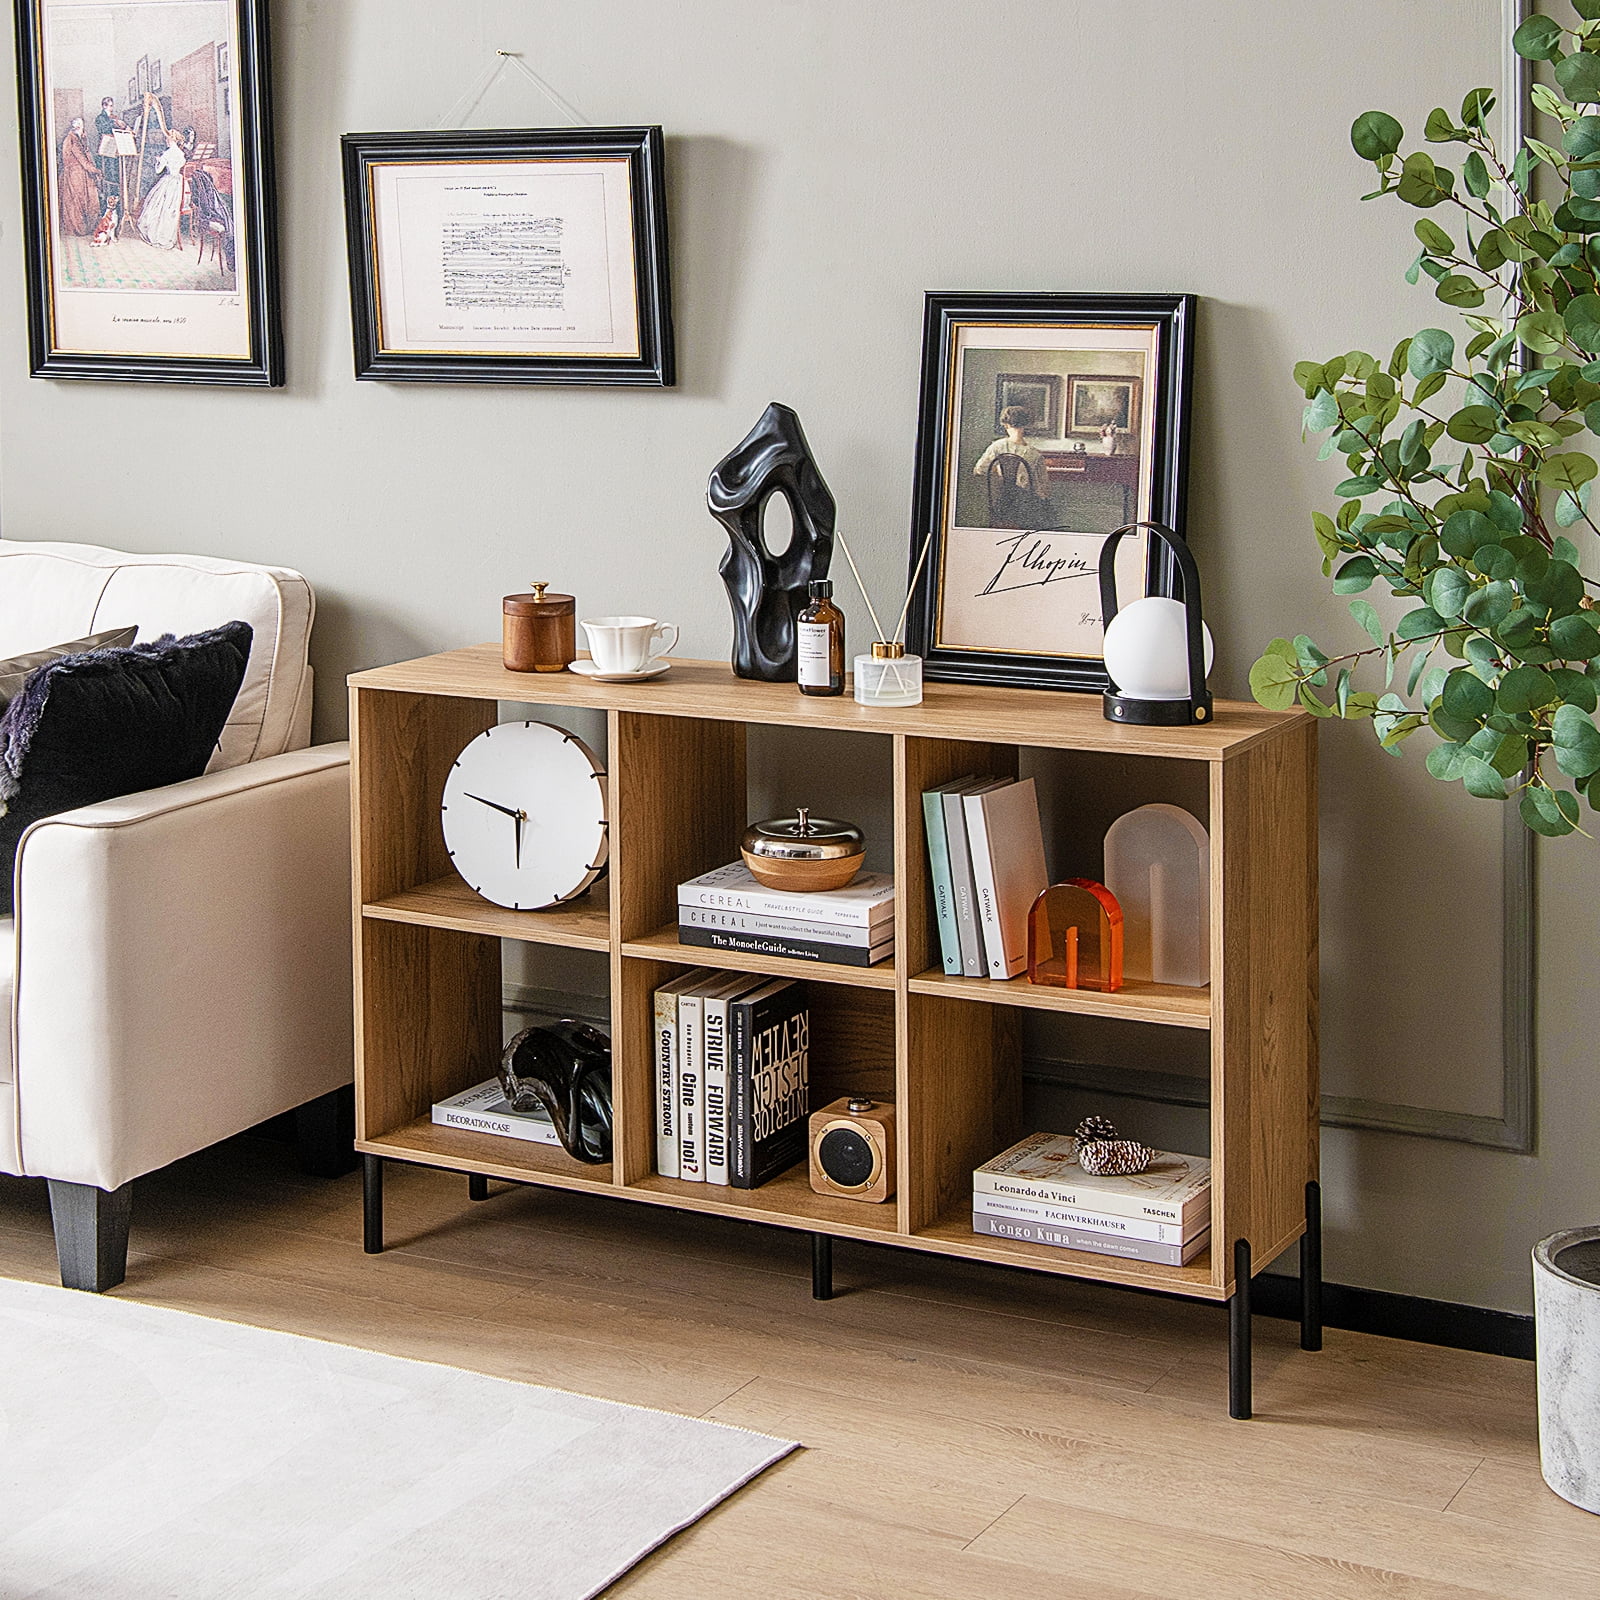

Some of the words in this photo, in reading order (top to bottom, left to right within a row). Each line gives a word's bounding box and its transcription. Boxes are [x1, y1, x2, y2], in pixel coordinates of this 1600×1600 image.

[700, 893, 751, 909] CEREAL
[807, 908, 823, 916] GUIDE
[938, 885, 948, 919] CATWALK
[959, 886, 969, 921] CATWALK
[982, 888, 993, 923] CATWALK
[691, 911, 746, 928] CEREAL
[812, 928, 835, 936] beautiful
[835, 931, 852, 939] things
[711, 934, 728, 946] The
[661, 1029, 672, 1088] COUNTRY
[706, 1013, 724, 1073] STRIVE
[750, 1009, 809, 1080] REVIEW
[682, 1072, 697, 1107] Cine
[753, 1050, 809, 1117] DESIGN
[446, 1113, 492, 1129] DECORATION
[491, 1121, 511, 1133] CASE
[662, 1088, 673, 1137] STRONG
[707, 1084, 725, 1168] FORWARD
[751, 1085, 809, 1143] INTERIOR
[682, 1139, 699, 1174] noi?
[994, 1182, 1037, 1197] Leonardo
[1038, 1189, 1049, 1199] da
[1051, 1191, 1076, 1204] Vinci
[1142, 1207, 1176, 1219] TASCHEN
[990, 1219, 1031, 1238] Kengo
[1037, 1227, 1070, 1245] Kuma
[1092, 1240, 1102, 1248] the
[1103, 1243, 1119, 1251] dawn
[1119, 1245, 1139, 1254] comes
